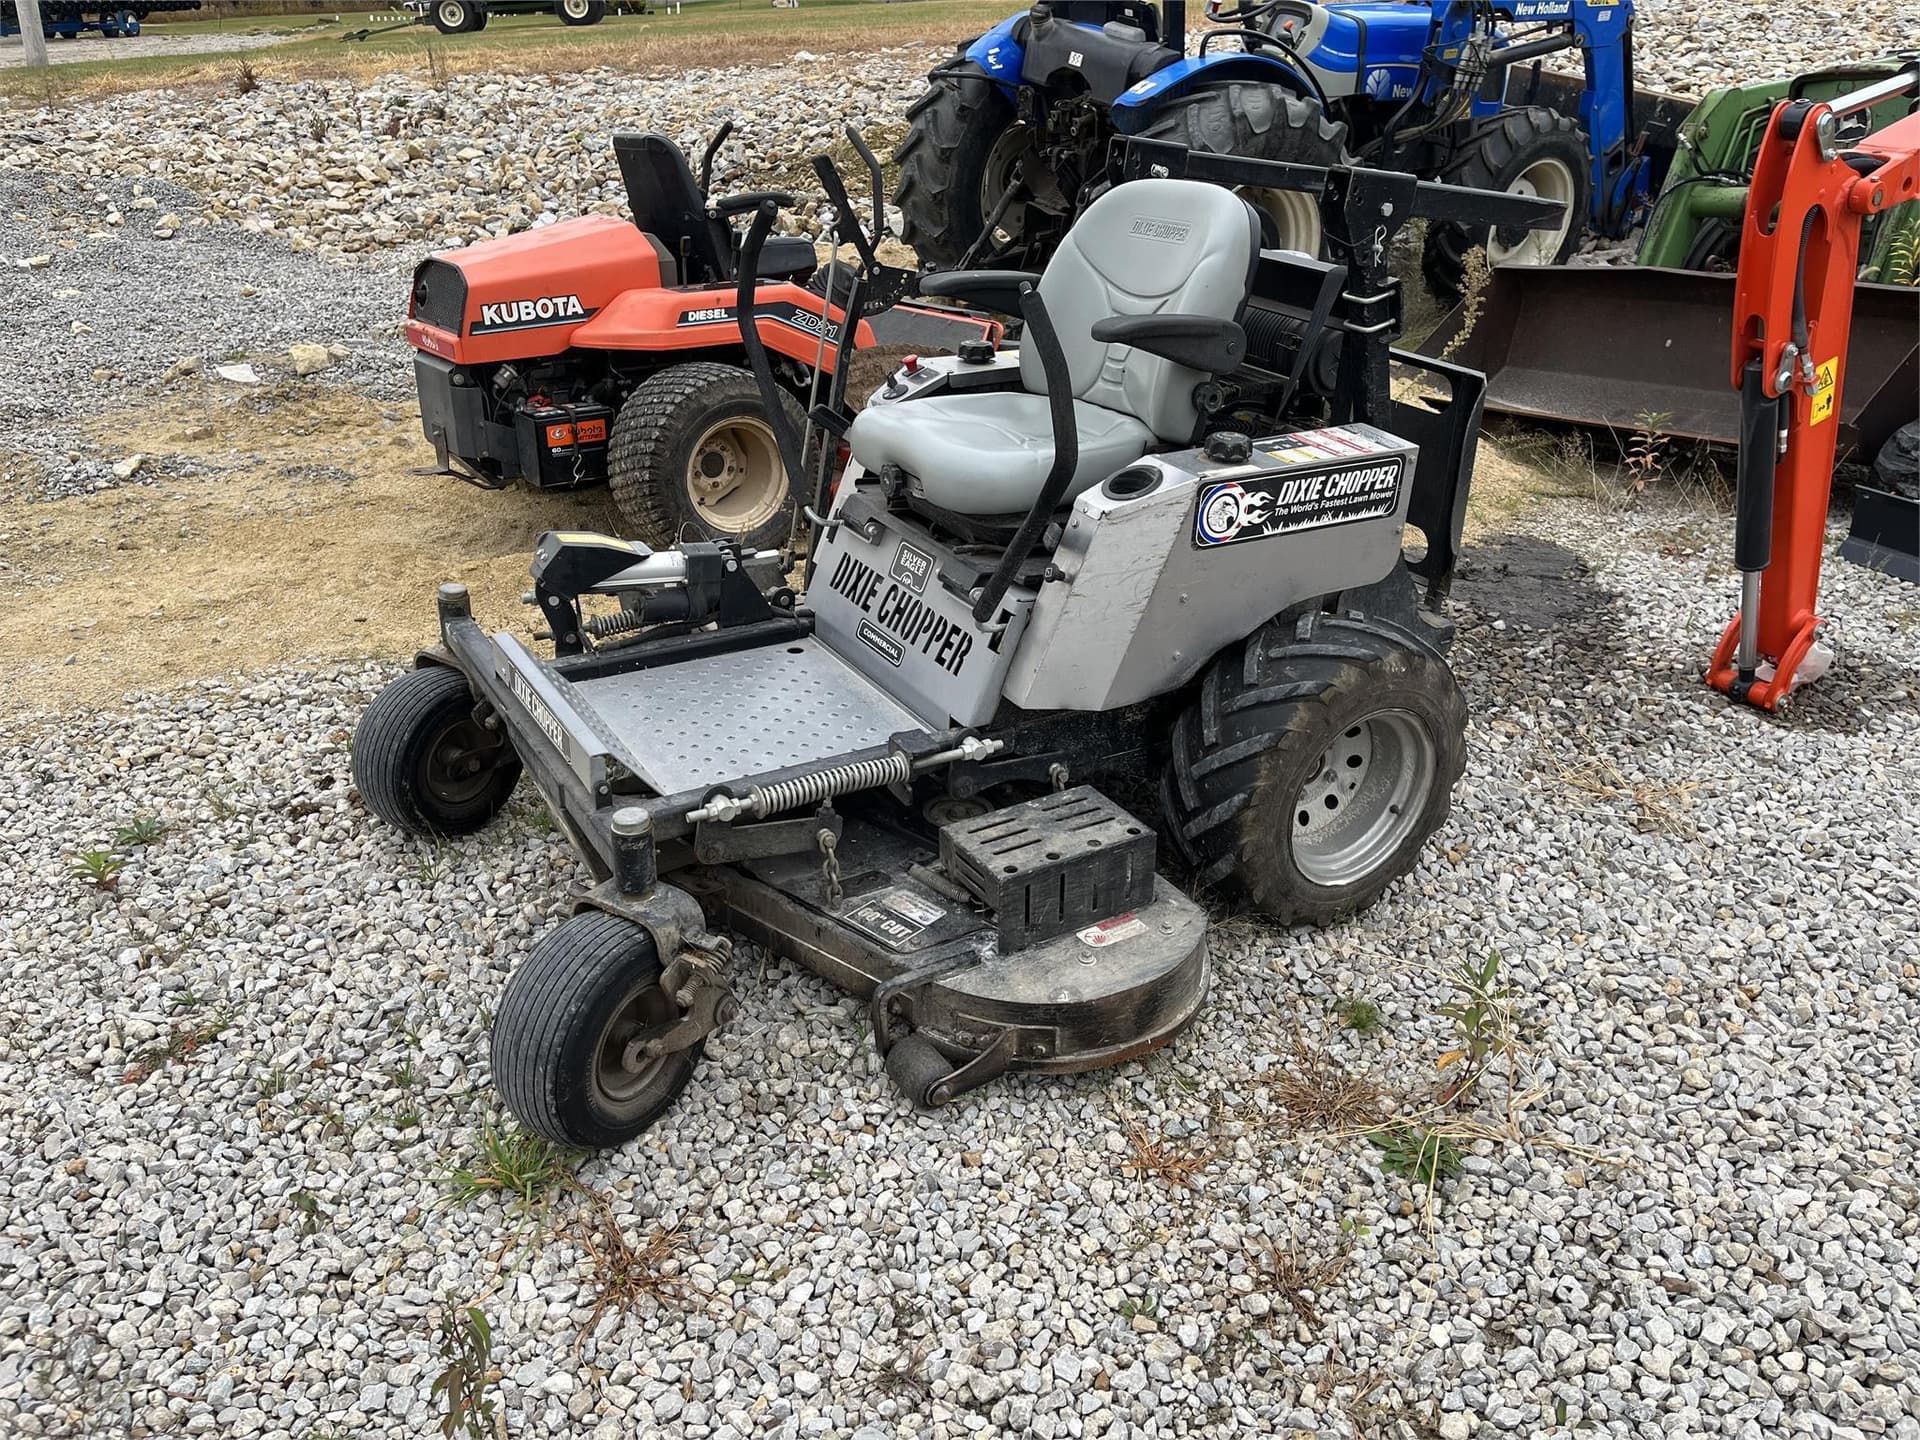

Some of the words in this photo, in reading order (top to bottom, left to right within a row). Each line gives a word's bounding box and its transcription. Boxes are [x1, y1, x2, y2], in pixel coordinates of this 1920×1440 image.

[1515, 2, 1536, 16] New
[1536, 1, 1570, 15] Holland
[481, 295, 585, 326] KUBOTA
[688, 308, 729, 322] DIESEL
[1276, 475, 1326, 506] DIXIE
[1329, 465, 1398, 497] CHOPPER
[1275, 507, 1289, 516] The
[1290, 502, 1319, 514] World's
[1320, 496, 1348, 509] Fastest
[1348, 494, 1369, 504] Lawn
[1369, 490, 1394, 501] Mower
[900, 557, 924, 577] EAGLE
[902, 550, 927, 570] SILVER
[829, 551, 885, 613] DIXIE
[877, 583, 973, 677] CHOPPER
[863, 627, 900, 658] COMMERCIAL
[514, 670, 533, 710] DIXIE
[531, 695, 564, 750] CHOPPER
[880, 919, 913, 939] CUT
